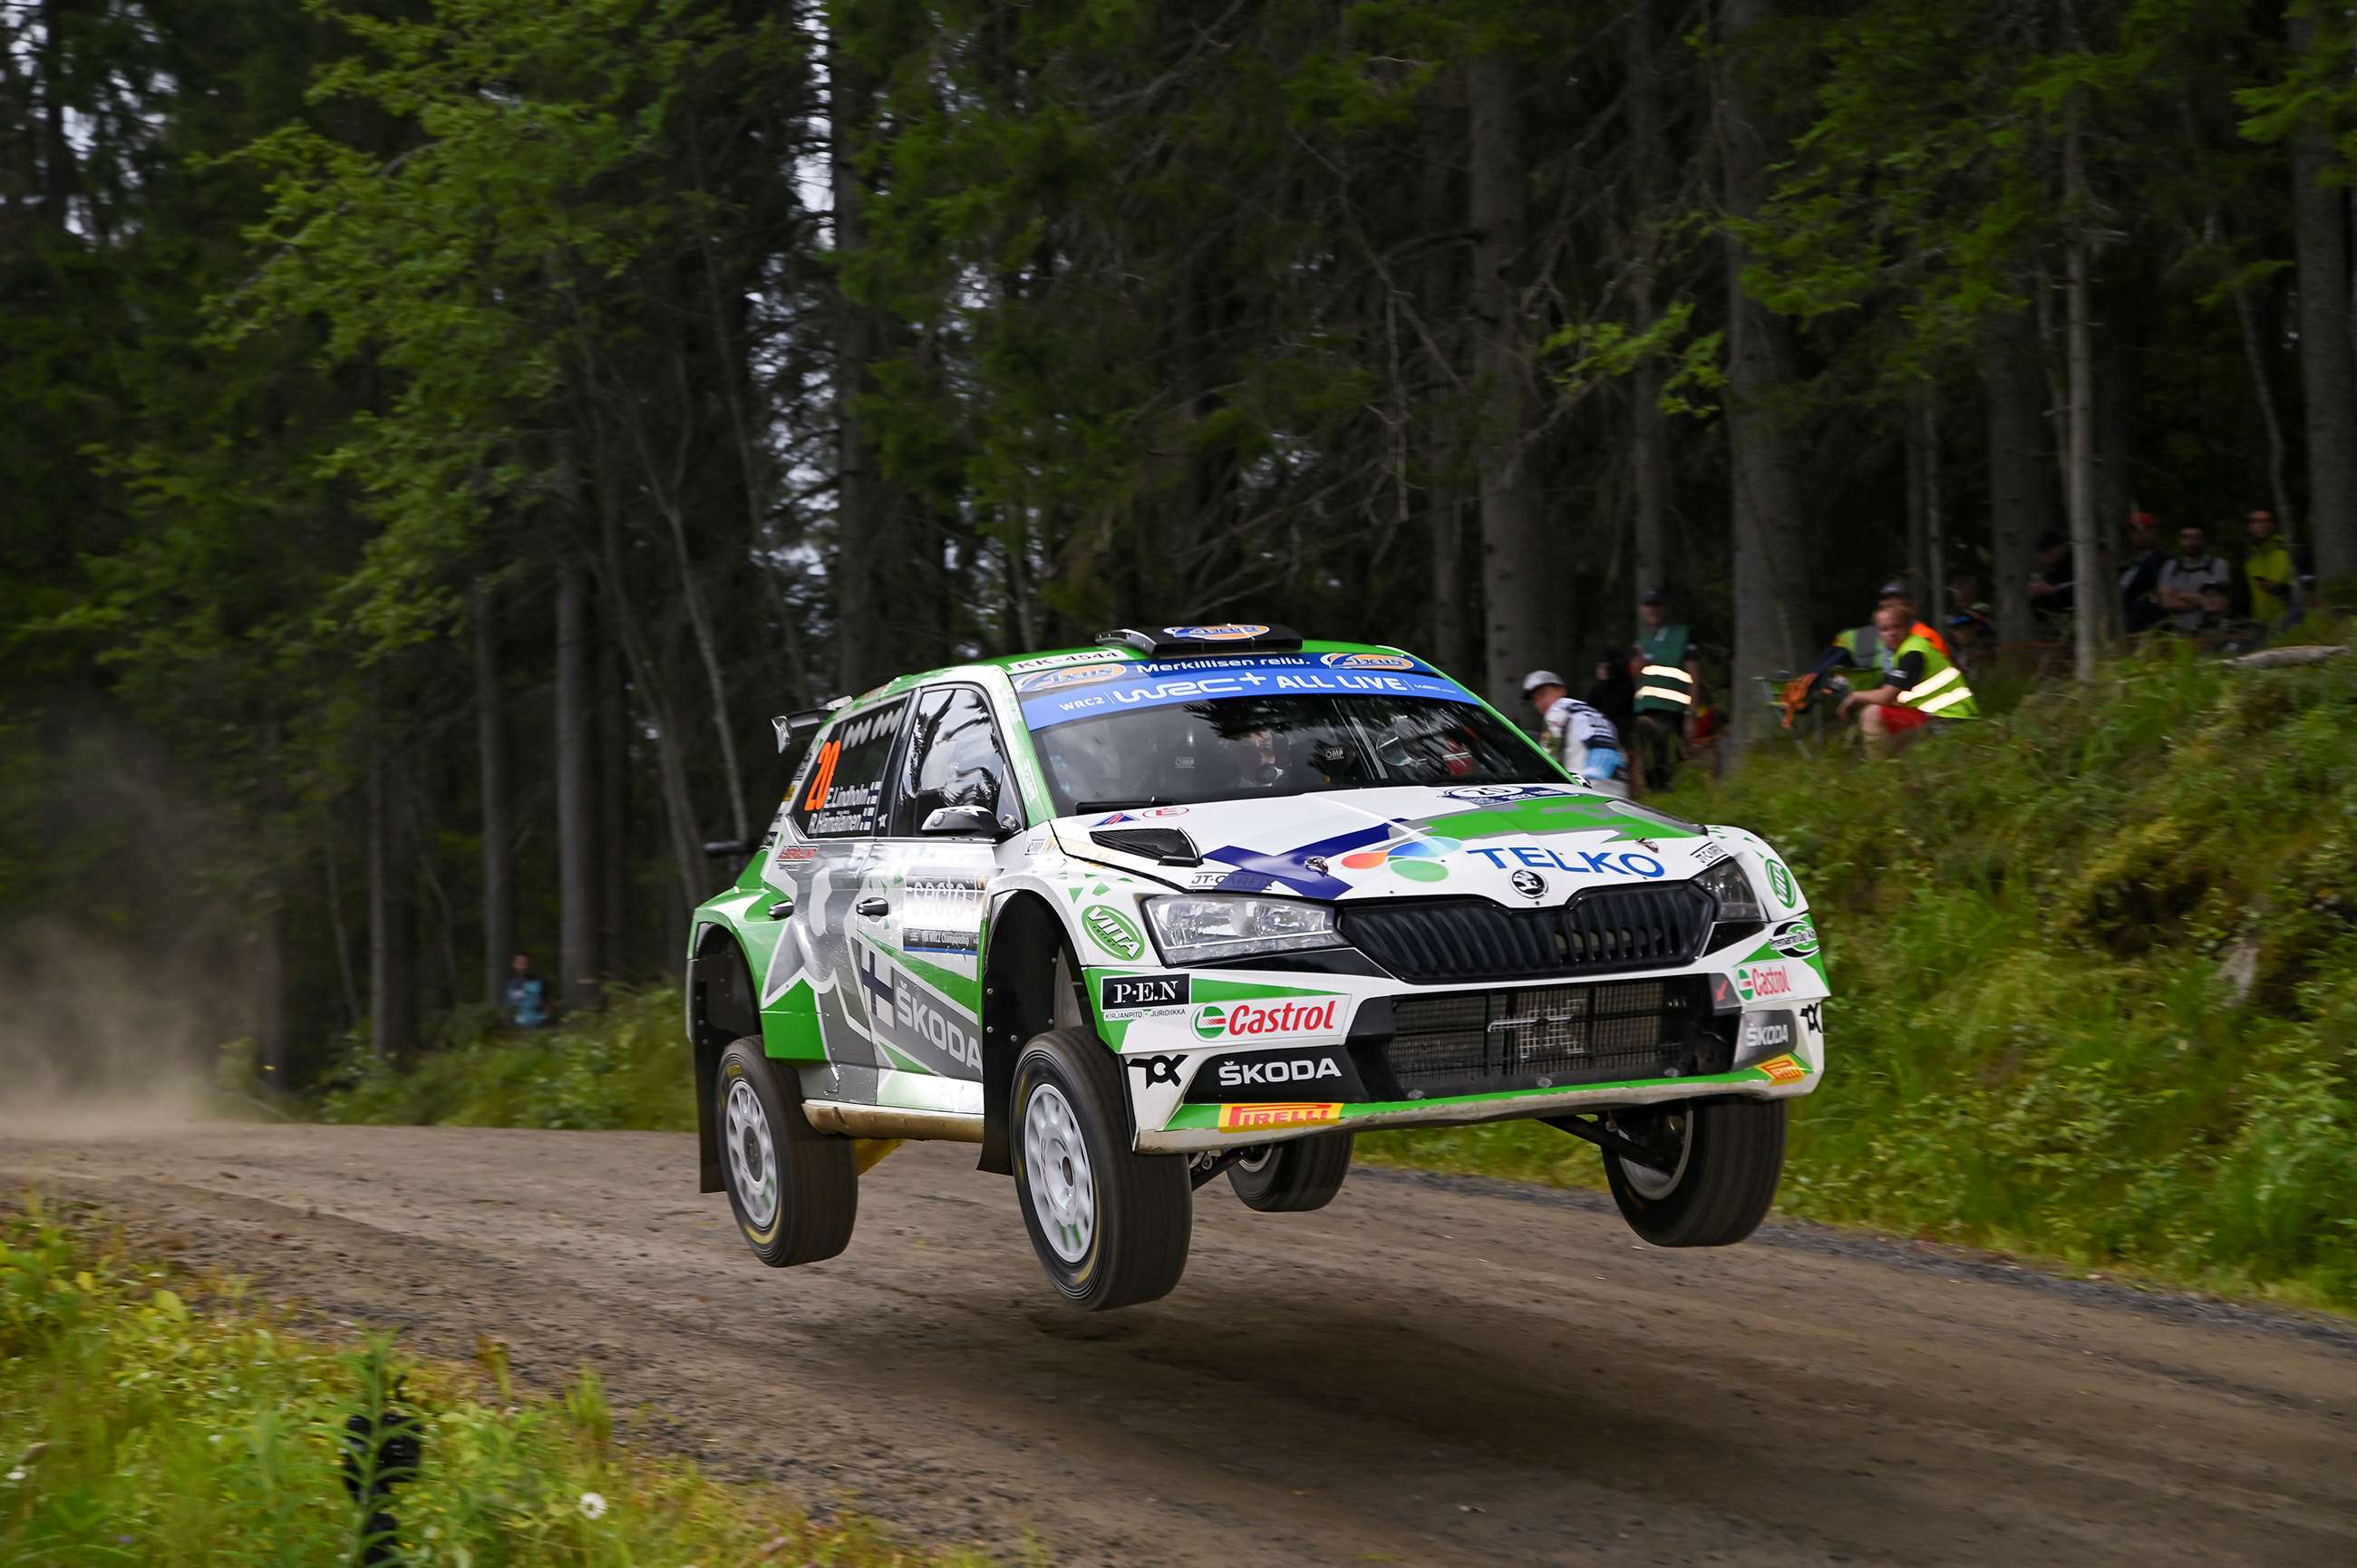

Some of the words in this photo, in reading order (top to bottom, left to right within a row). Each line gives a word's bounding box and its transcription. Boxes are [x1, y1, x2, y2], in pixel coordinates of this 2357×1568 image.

[1017, 652, 1119, 669] KK-4544
[1137, 657, 1256, 674] Merkillisen
[1258, 655, 1311, 667] reilu.
[1059, 696, 1106, 711] WRC2
[1275, 674, 1336, 692] ALL
[1336, 675, 1409, 692] LIVE
[1174, 758, 1196, 767] OMP
[1324, 749, 1345, 760] OMP
[803, 739, 842, 812] 20
[1461, 787, 1512, 797] 20
[1465, 846, 1665, 878] TELKO
[1088, 906, 1140, 958] VIITA
[1751, 965, 1792, 997] Castrol
[1105, 1011, 1142, 1020] KIRJANPITO
[1150, 1008, 1186, 1017] JURIDIIKKA
[1227, 1000, 1337, 1037] Castrol
[895, 979, 984, 1077] ŠKODA
[1746, 1022, 1789, 1047] ŠKODA
[1218, 1058, 1343, 1087] ŠKODA
[1228, 1103, 1334, 1128] PIRELLI
